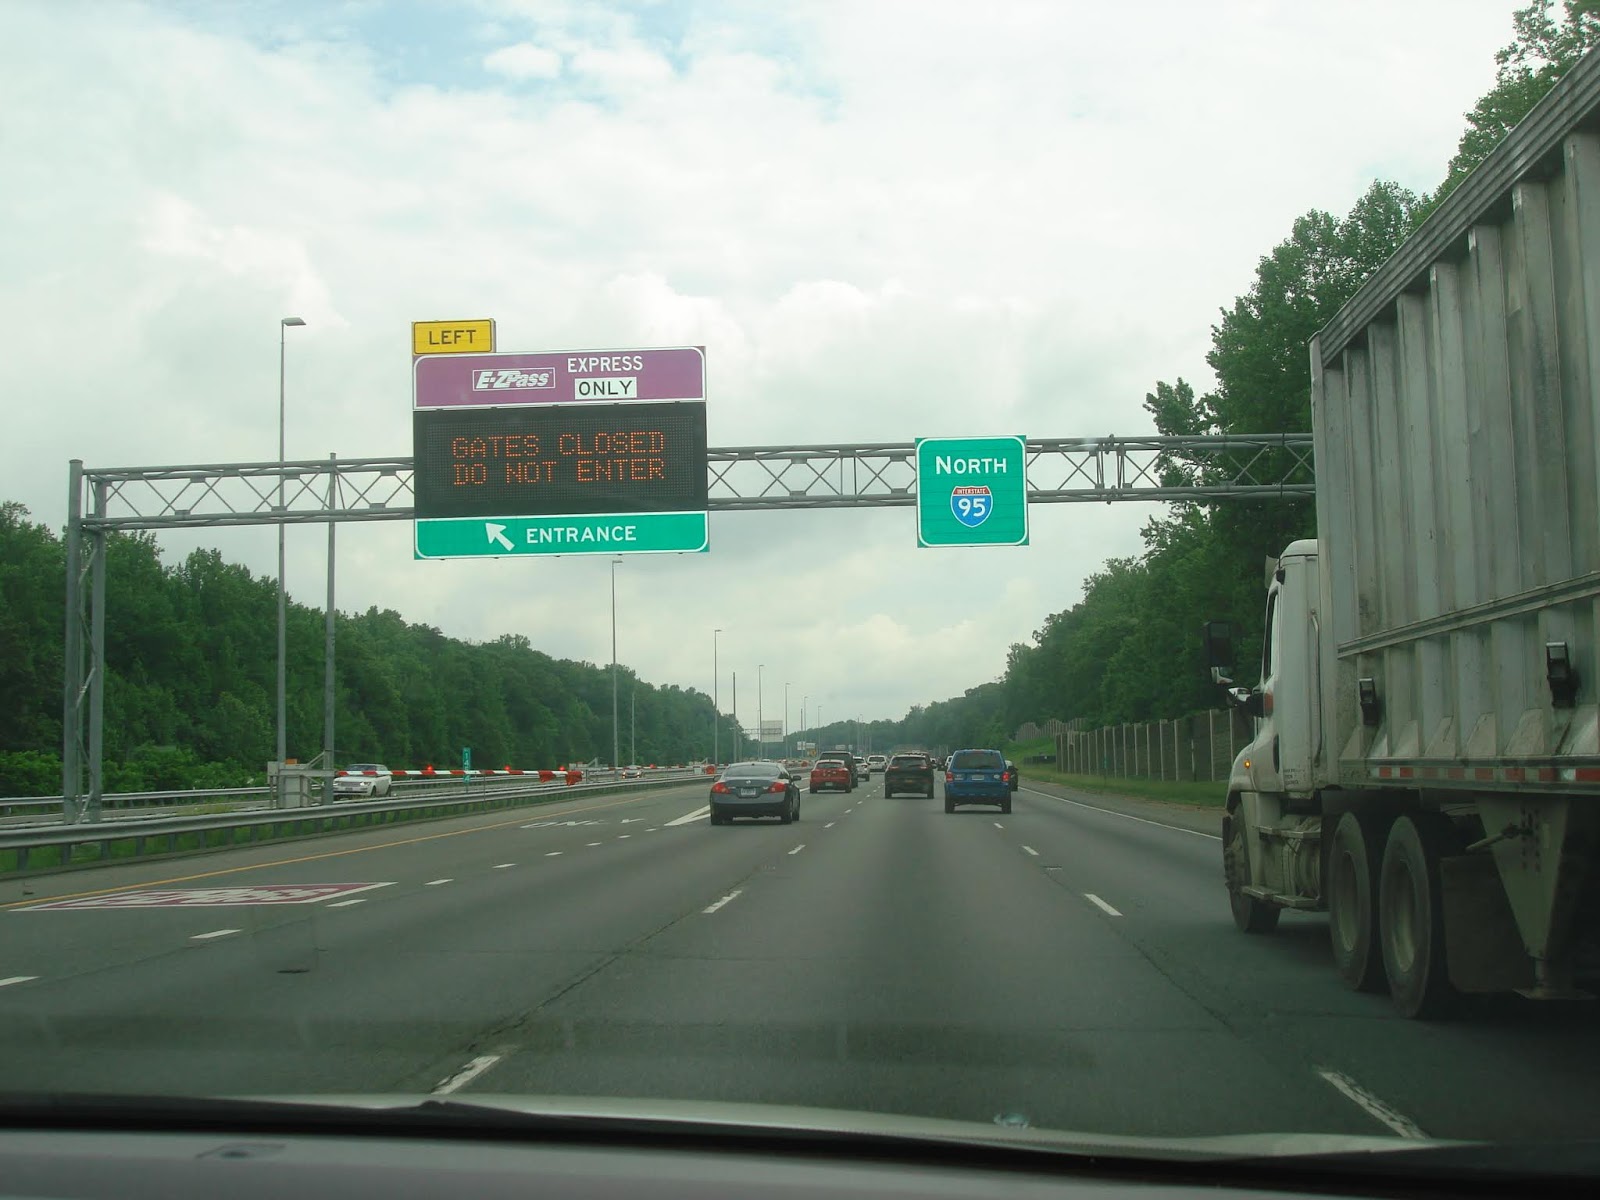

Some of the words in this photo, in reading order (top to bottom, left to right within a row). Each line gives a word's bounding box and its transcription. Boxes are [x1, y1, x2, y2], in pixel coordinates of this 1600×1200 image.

[429, 330, 476, 345] LEFT
[567, 356, 643, 373] EXPRESS
[475, 370, 550, 388] E-ZPass
[578, 380, 633, 395] ONLY
[453, 435, 540, 458] GATES
[559, 431, 665, 455] CLOSED
[453, 463, 487, 485] DO
[506, 461, 557, 483] NOT
[577, 458, 665, 481] ENTER
[935, 456, 1007, 474] NORTH
[958, 498, 986, 517] 95
[526, 525, 637, 544] ENTRANCE
